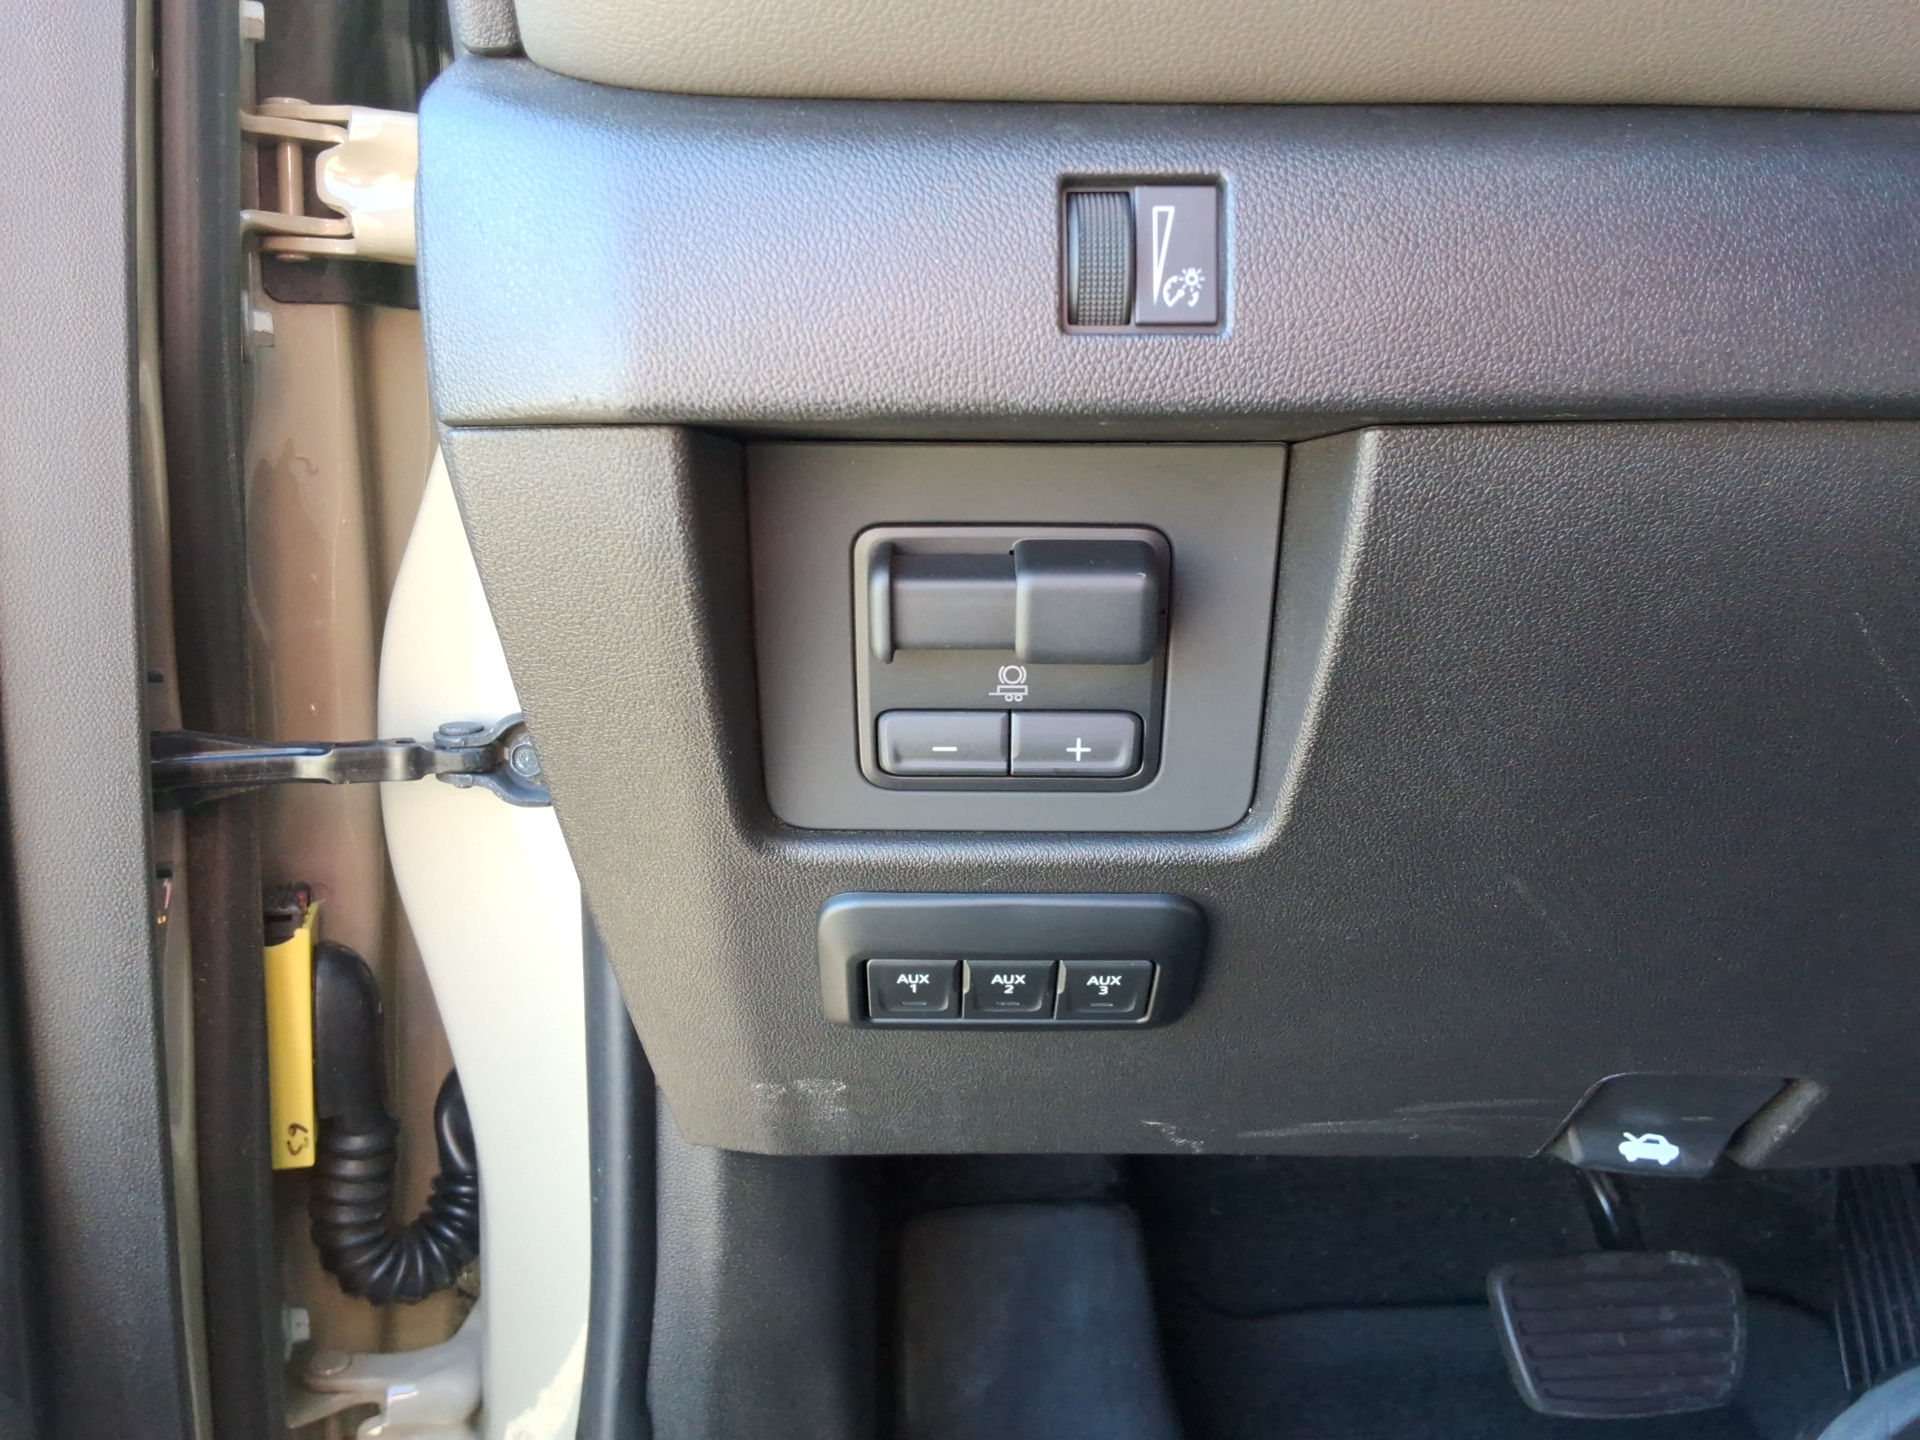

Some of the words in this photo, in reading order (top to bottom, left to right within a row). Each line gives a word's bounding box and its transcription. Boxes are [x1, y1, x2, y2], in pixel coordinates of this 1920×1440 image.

[897, 974, 930, 985] AUX
[991, 974, 1026, 985] AUX
[1086, 975, 1122, 986] AUX
[910, 984, 917, 993] 1
[1004, 984, 1014, 994] 2
[1098, 986, 1108, 995] 3
